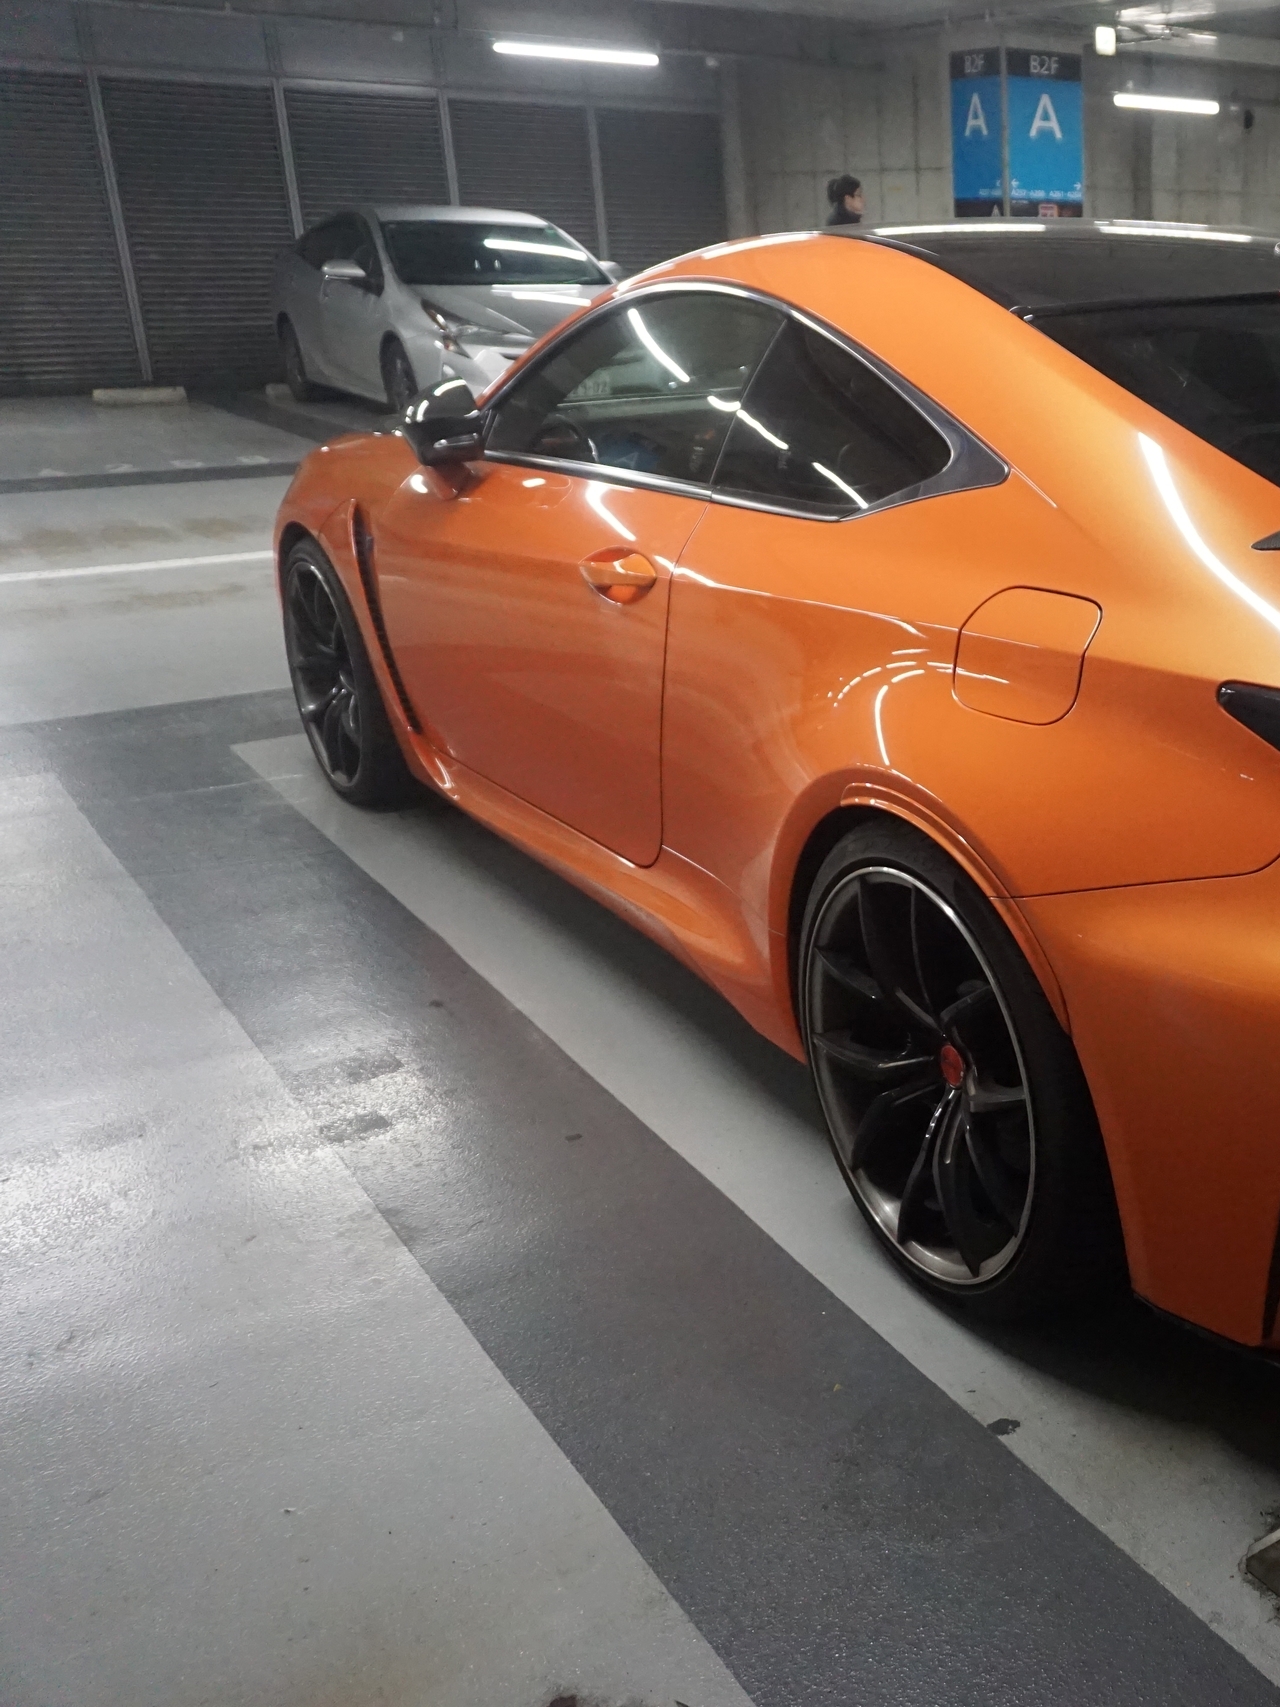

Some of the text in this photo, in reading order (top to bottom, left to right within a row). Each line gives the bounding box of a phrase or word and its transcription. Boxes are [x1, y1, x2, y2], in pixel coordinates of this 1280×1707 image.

[964, 54, 984, 73] B2F
[1029, 55, 1059, 75] B2F
[964, 92, 988, 137] A
[1029, 93, 1062, 139] A
